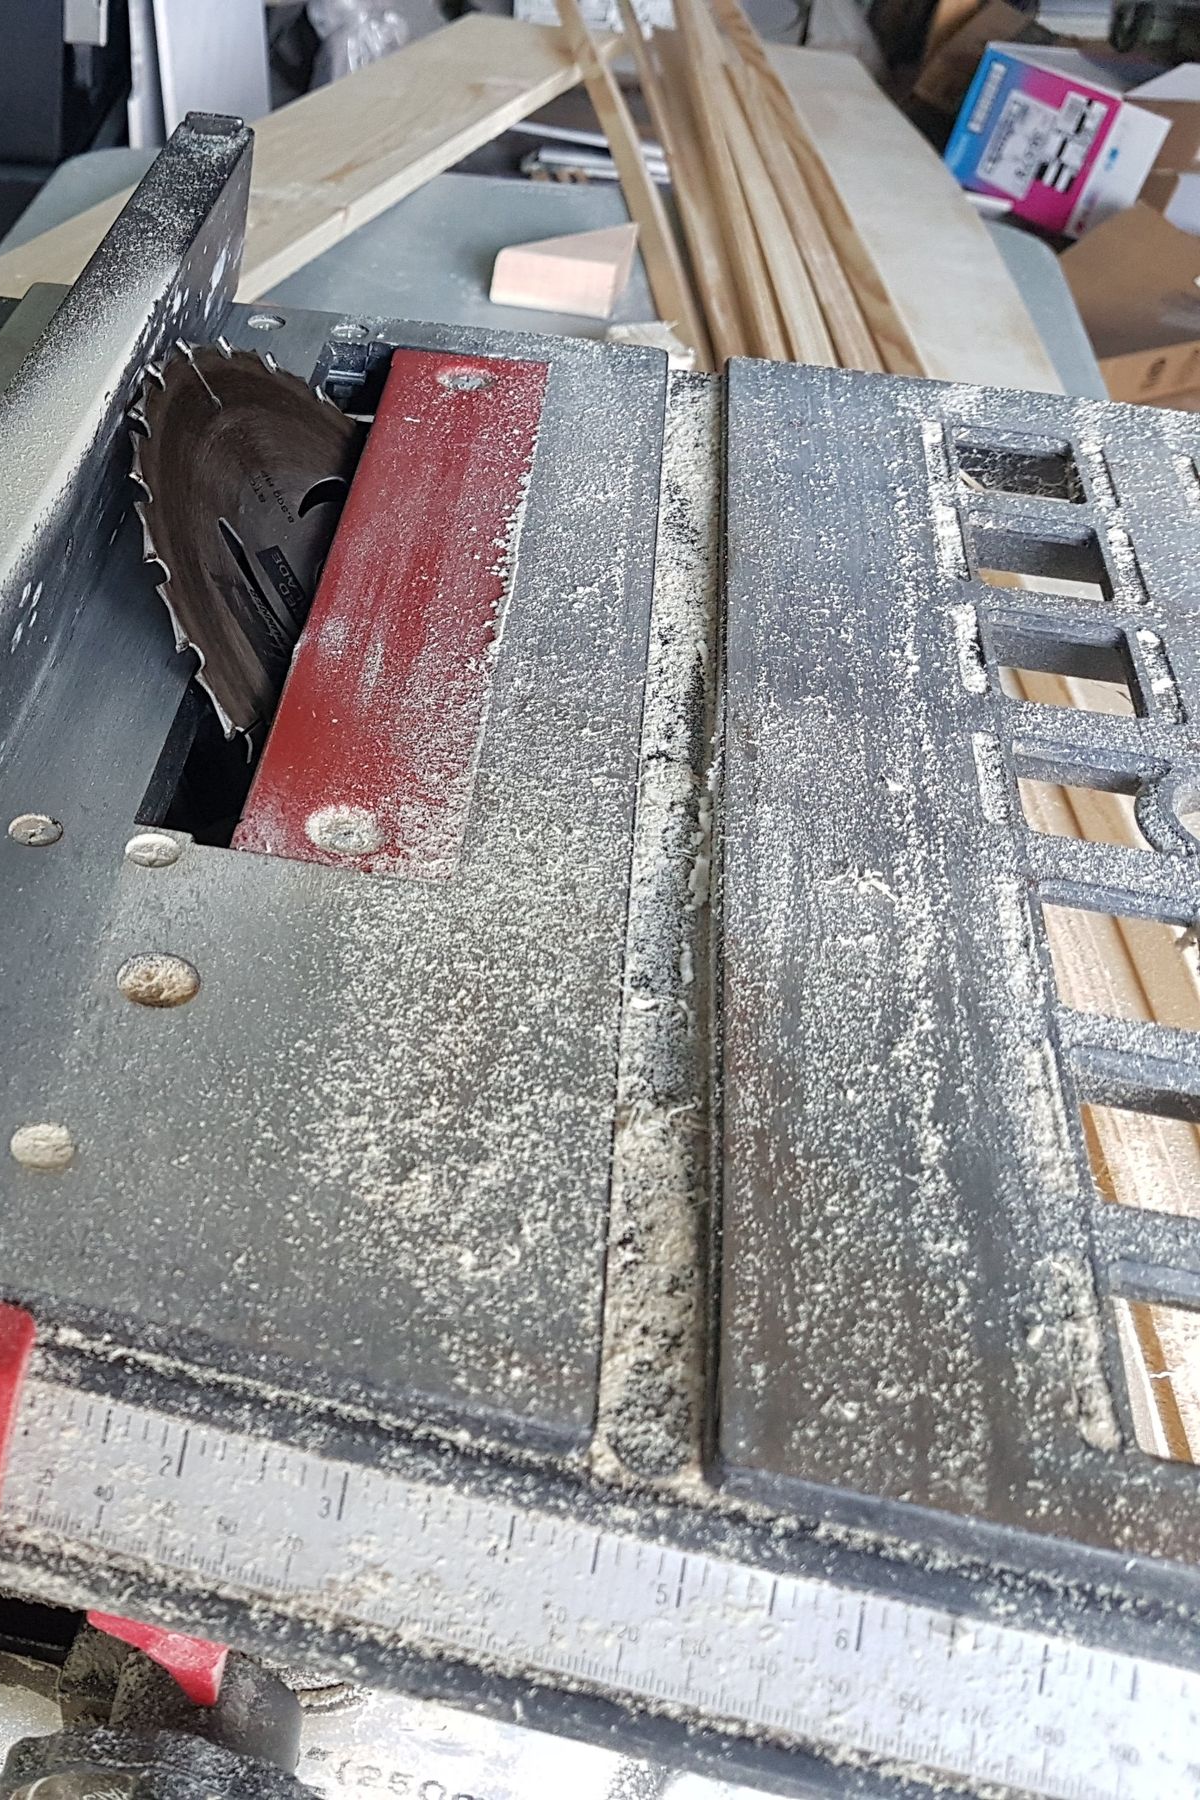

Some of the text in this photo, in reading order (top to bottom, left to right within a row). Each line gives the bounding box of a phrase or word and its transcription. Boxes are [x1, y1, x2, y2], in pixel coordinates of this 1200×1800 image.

[157, 1453, 173, 1477] 2
[316, 1495, 333, 1519] 3
[653, 1582, 670, 1606] 5
[833, 1627, 853, 1652] 6
